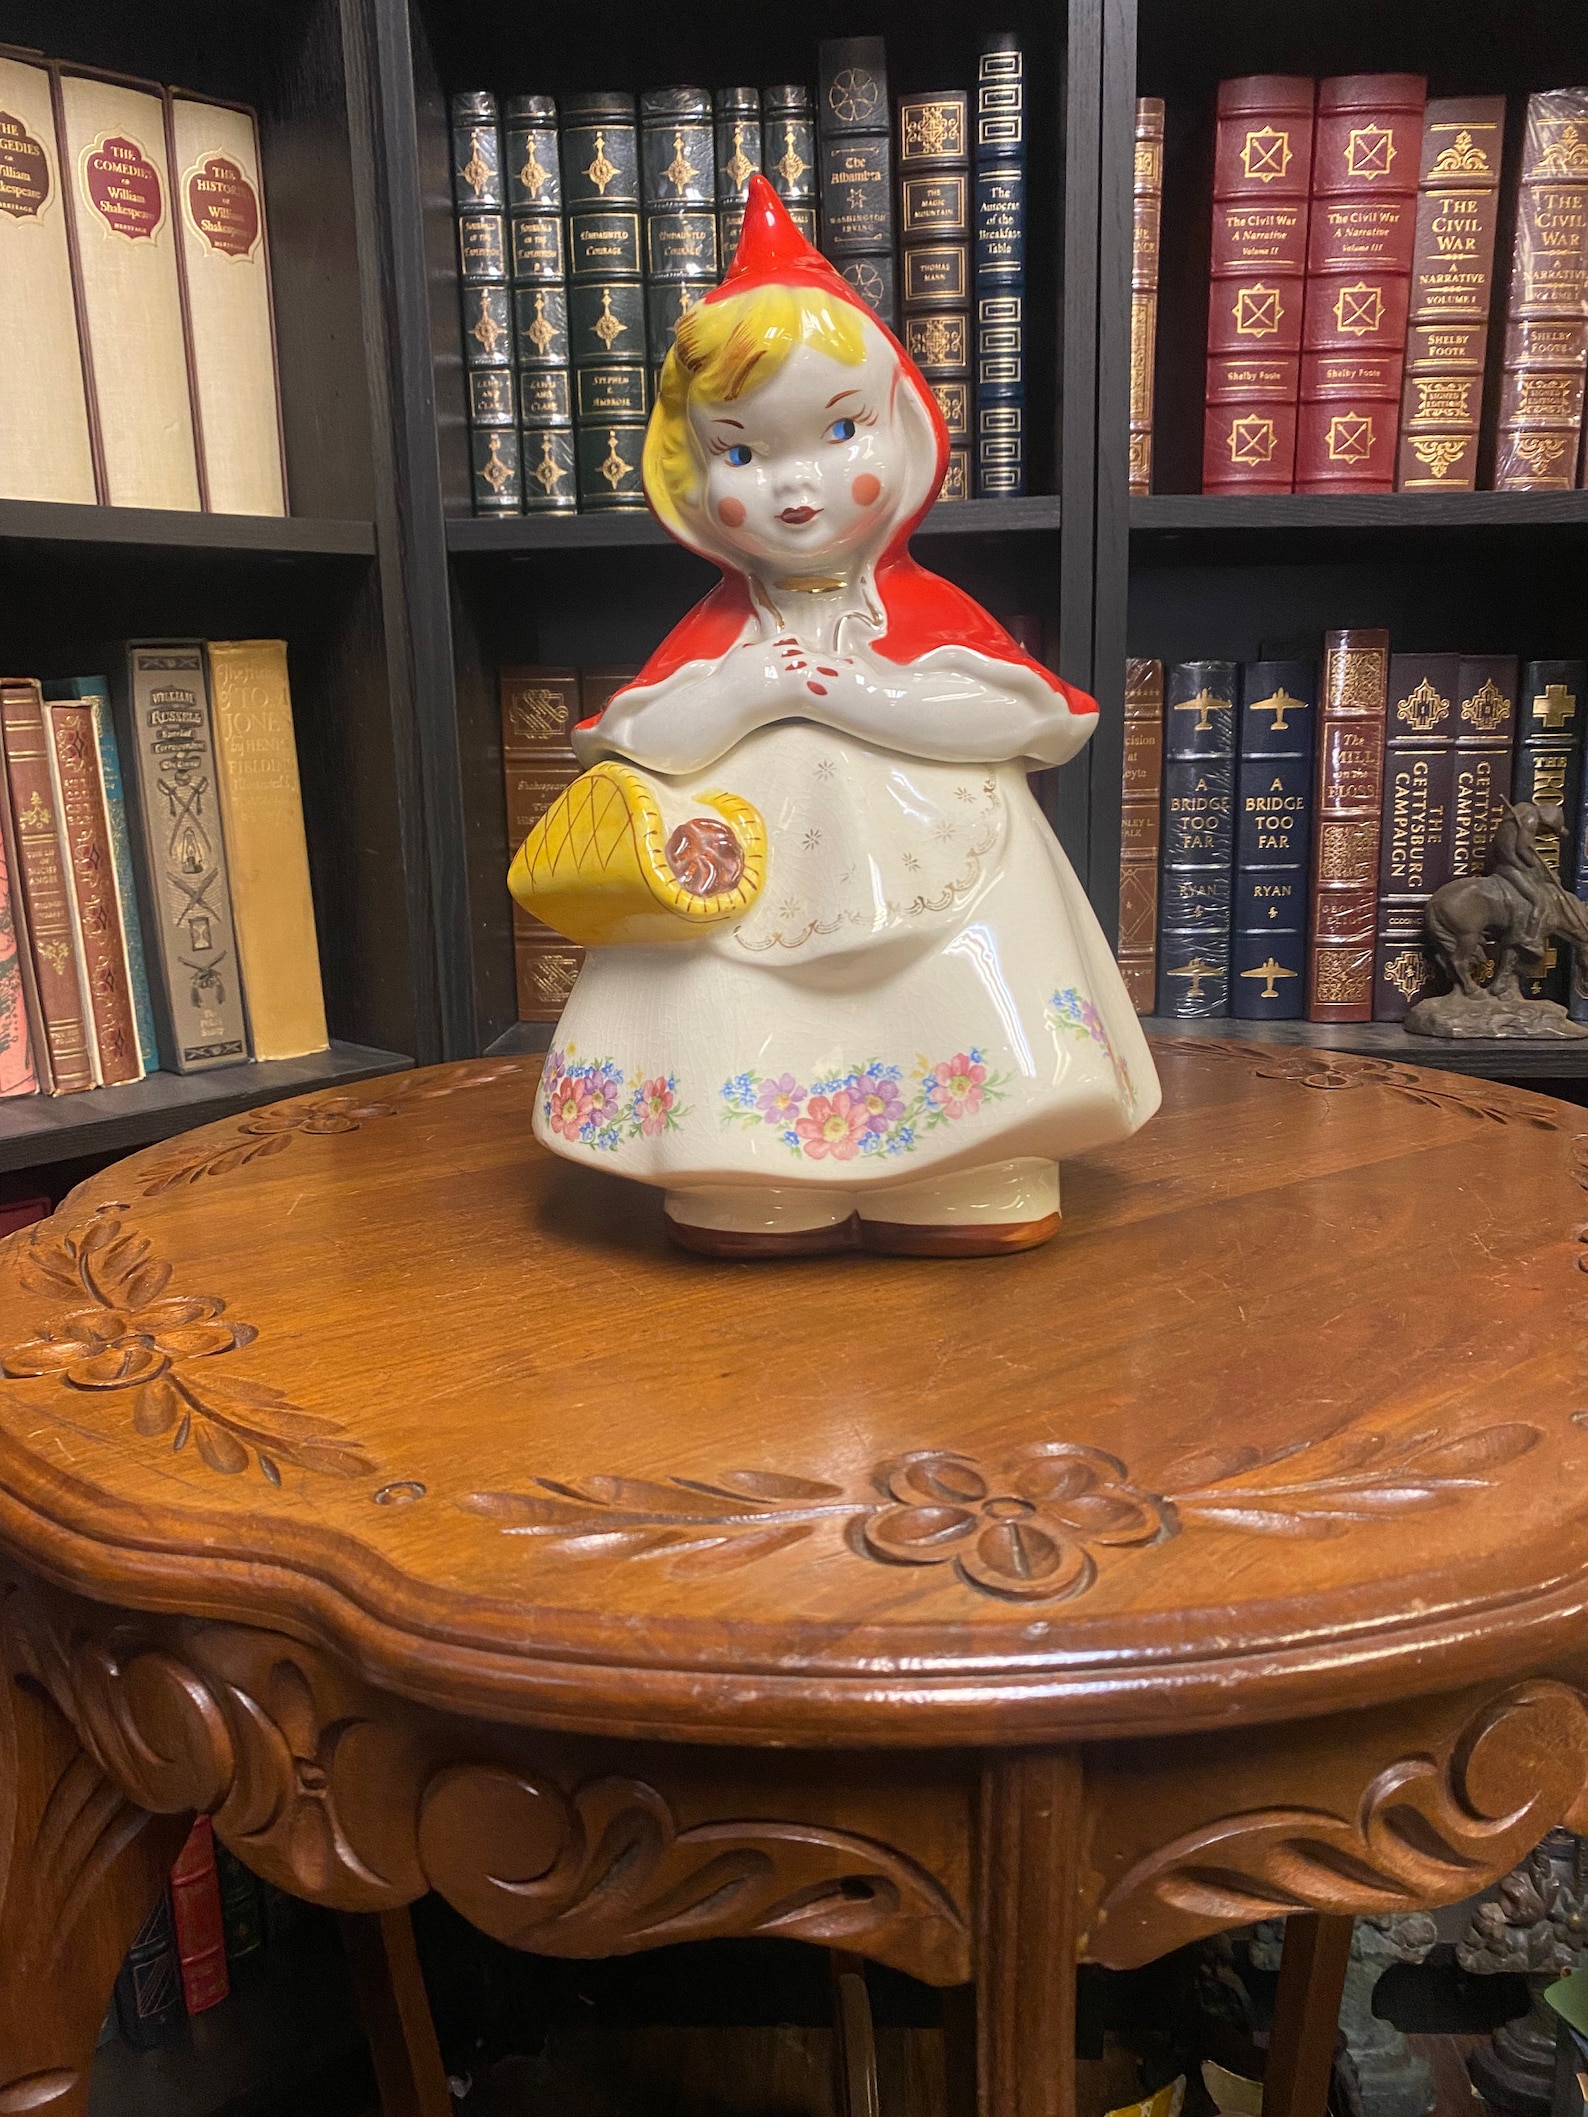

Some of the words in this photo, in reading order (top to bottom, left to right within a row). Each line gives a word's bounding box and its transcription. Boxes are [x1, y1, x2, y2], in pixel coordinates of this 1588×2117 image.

[0, 138, 40, 155] GEDIES
[845, 157, 866, 169] The
[831, 170, 882, 184] Alhambra
[0, 180, 41, 198] kespeare
[107, 186, 145, 204] William
[927, 188, 941, 196] THE
[990, 186, 1011, 198] The
[921, 199, 945, 207] MAGIC
[1438, 199, 1478, 214] THE
[1544, 195, 1583, 209] THE
[914, 208, 953, 218] MOUNTAIN
[986, 213, 997, 225] of
[999, 213, 1014, 224] the
[1327, 213, 1348, 224] The
[1350, 212, 1378, 222] Civil
[1380, 212, 1400, 222] War
[1226, 217, 1246, 227] The
[1247, 215, 1274, 226] Civil
[1276, 215, 1296, 225] War
[1431, 217, 1482, 233] CIVIL
[1538, 213, 1586, 228] CIVIL
[1232, 231, 1240, 240] A
[1242, 230, 1287, 240] Narrative
[1334, 228, 1342, 237] A
[1344, 227, 1389, 237] Narrative
[1437, 236, 1476, 250] WAR
[1541, 232, 1580, 246] WAR
[988, 242, 1012, 254] Table
[1242, 247, 1269, 255] Volume
[920, 263, 950, 271] THOMAS
[1449, 263, 1457, 272] A
[1554, 260, 1561, 268] A
[1420, 274, 1485, 284] NARRATIVE
[1426, 296, 1470, 304] VOLUME
[1428, 334, 1469, 344] SHELBY
[1530, 331, 1571, 341] SHELBY
[1429, 347, 1465, 356] FOOTE
[1531, 343, 1567, 352] FOOTE
[1227, 371, 1256, 381] Shelby
[1259, 371, 1281, 380] Foote
[1326, 368, 1356, 378] Shelby
[1359, 368, 1380, 377] Foote
[1429, 392, 1459, 400] SIGNED
[152, 691, 194, 704] WILLIAM
[151, 710, 202, 724] RUSSELL
[223, 713, 291, 741] JONE
[1125, 735, 1155, 745] cision
[1343, 733, 1365, 746] The
[228, 758, 295, 775] FIELDI
[1533, 756, 1567, 768] THE
[1123, 769, 1147, 780] eyte
[1195, 778, 1208, 791] A
[1270, 777, 1283, 791] A
[1327, 784, 1375, 799] FLOSS
[1170, 797, 1229, 811] BRIDGE
[1245, 796, 1304, 811] BRIDGE
[1122, 819, 1144, 827] NLEY
[1180, 816, 1219, 829] TOO
[1255, 816, 1294, 829] TOO
[1391, 772, 1410, 876] CAMPAIGN
[1408, 761, 1428, 887] GETTYSBURG
[1427, 805, 1443, 843] THE
[1453, 772, 1474, 875] CAMPAIGN
[1471, 761, 1491, 877] GETTYSBUR
[1122, 829, 1142, 837] ALK
[1184, 835, 1214, 848] FAR
[1258, 835, 1290, 848] FAR
[1179, 884, 1217, 896] RYAN
[1253, 885, 1292, 897] RYAN
